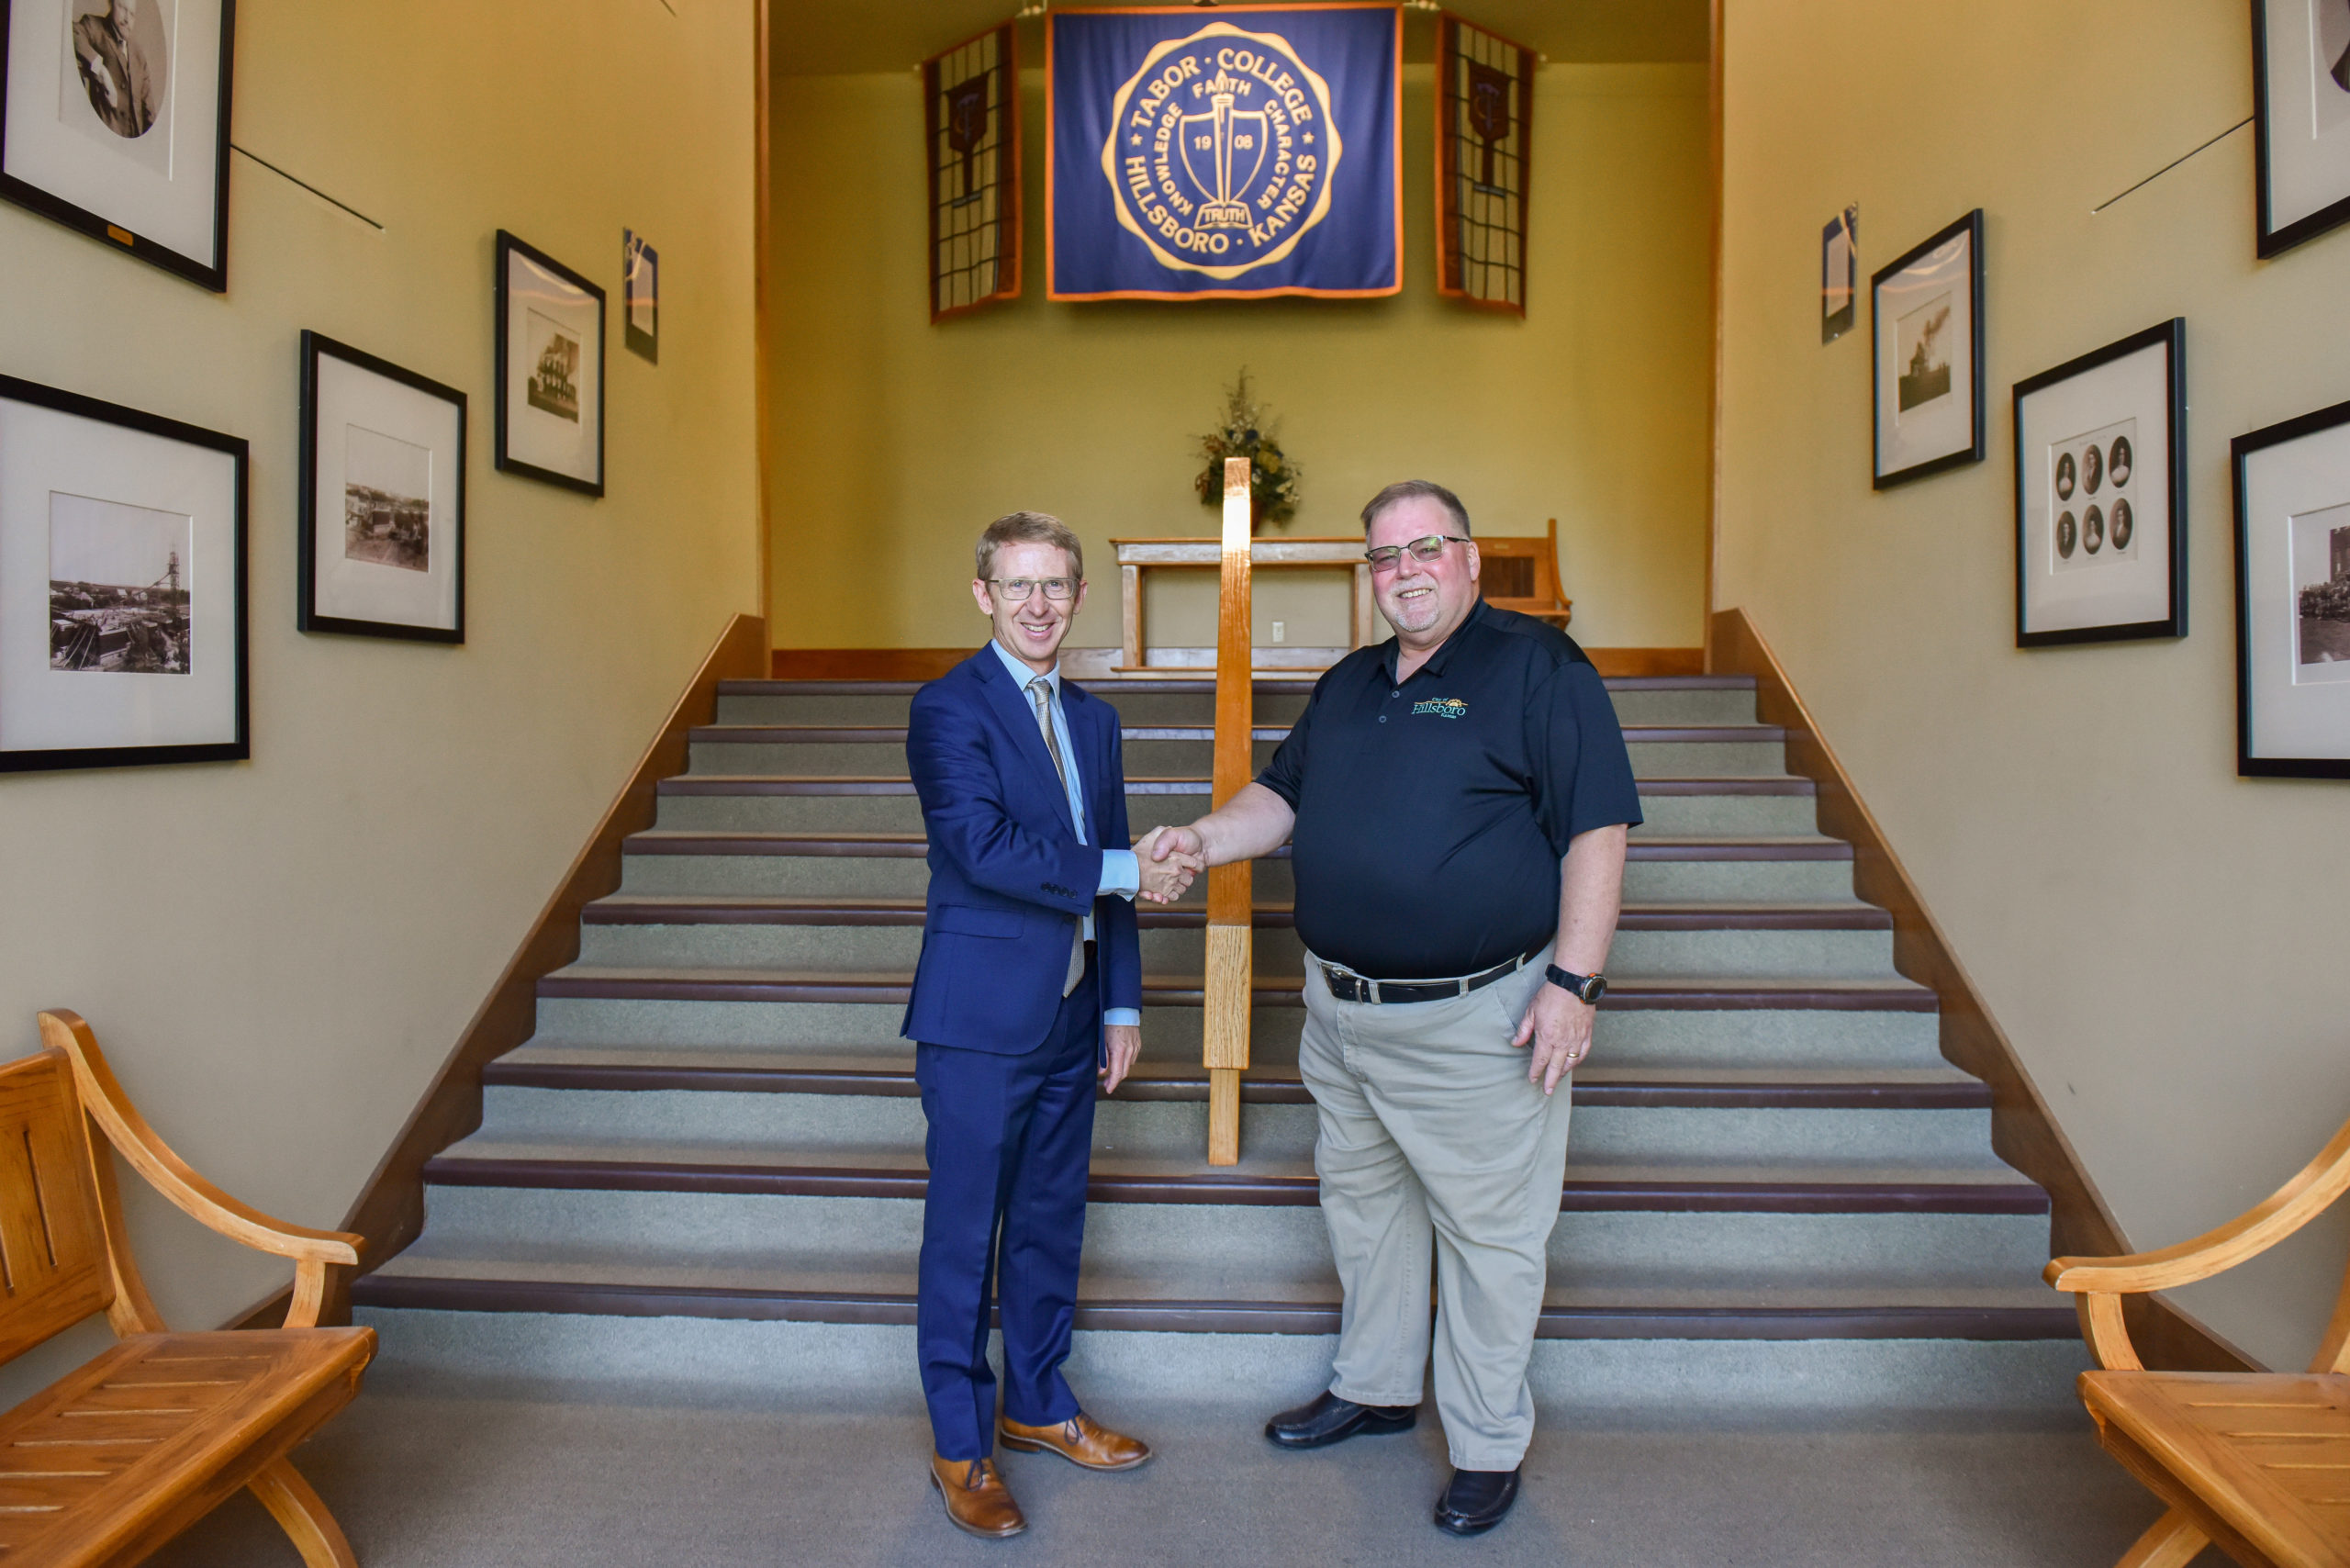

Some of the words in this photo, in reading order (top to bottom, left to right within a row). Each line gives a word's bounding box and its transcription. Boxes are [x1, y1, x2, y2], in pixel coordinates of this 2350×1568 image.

[1131, 55, 1202, 128] TABOR
[1217, 47, 1314, 126] COLLEGE
[1192, 76, 1252, 99] FAITH
[1154, 102, 1194, 217] KNOWLEDGE
[1194, 135, 1213, 151] 19
[1234, 134, 1254, 151] 08
[1257, 99, 1292, 209] CHARACTER
[1125, 155, 1230, 254] HILLSBORO
[1248, 154, 1317, 248] KANSAS
[1204, 207, 1247, 223] TRUTH
[1411, 702, 1466, 715] Hillsboro
